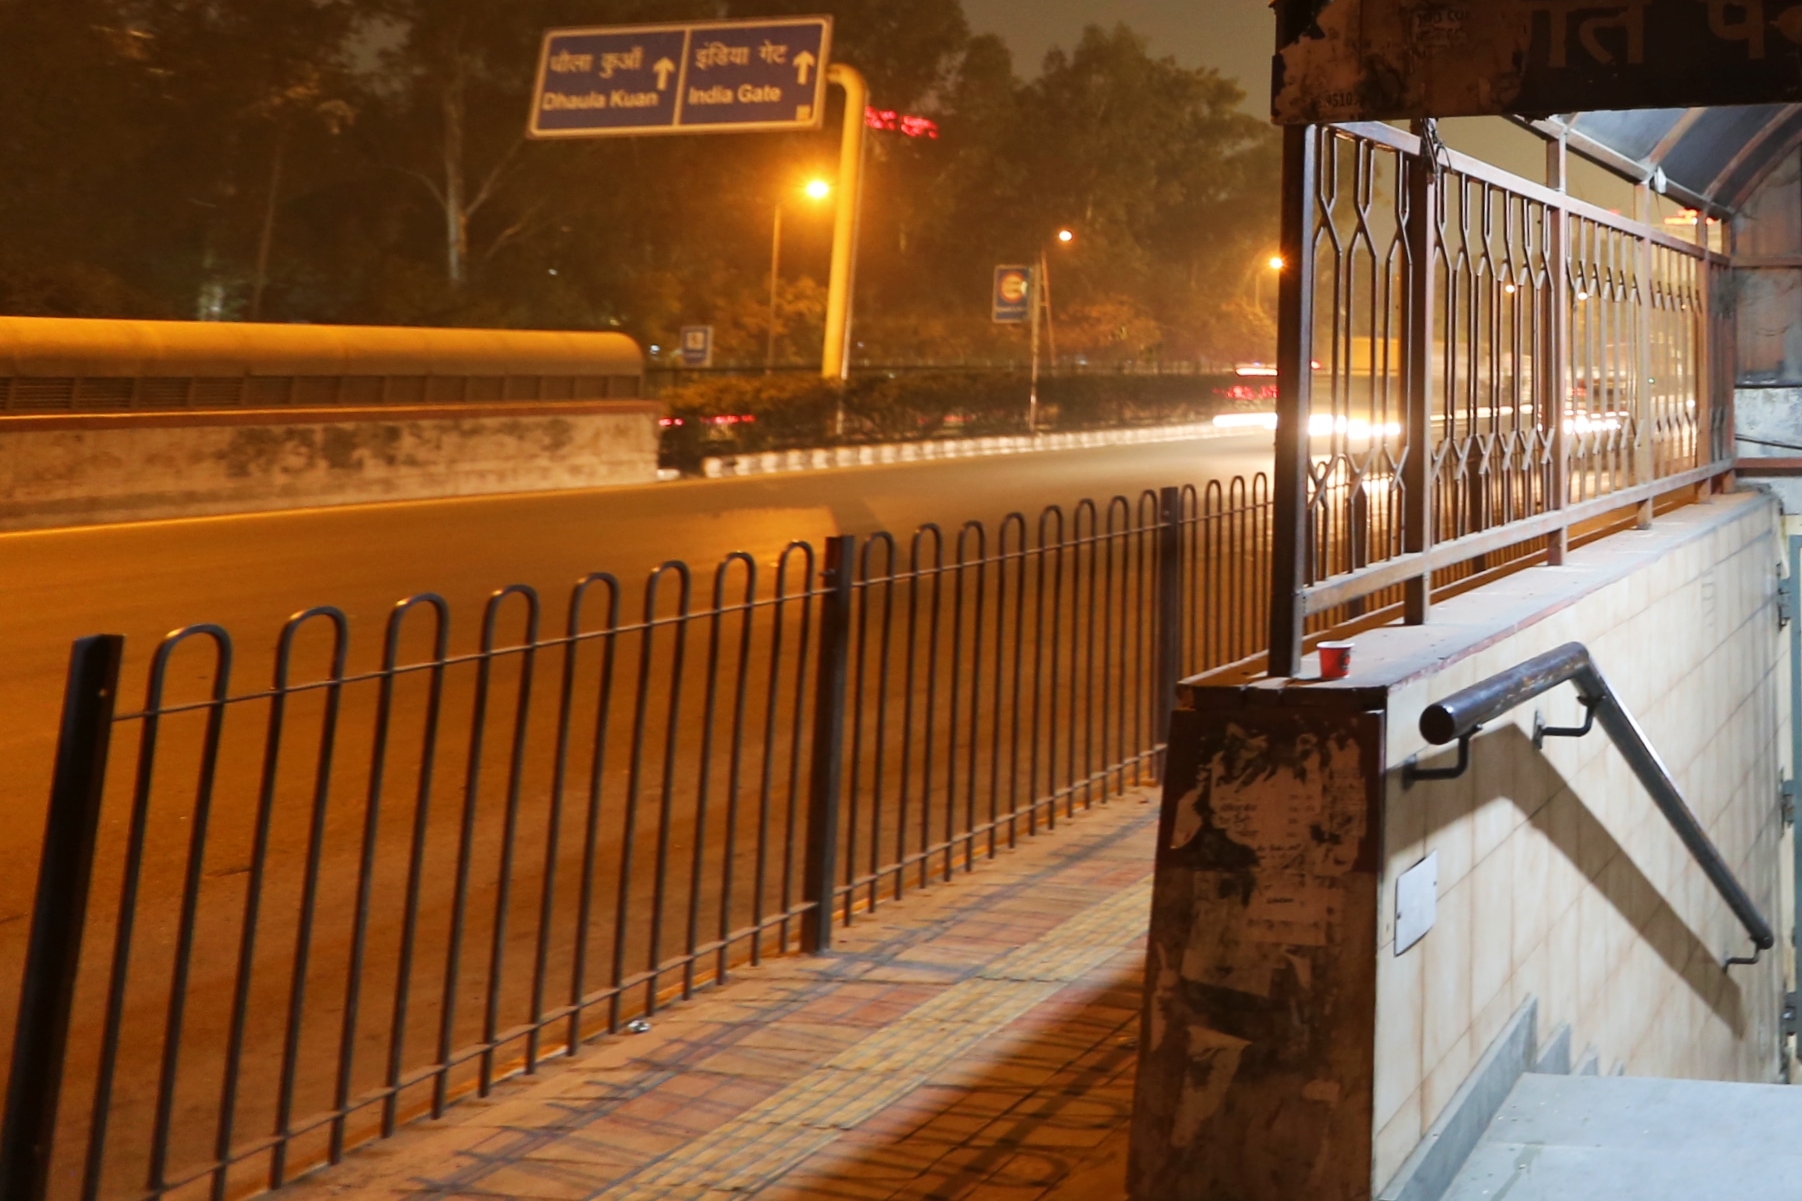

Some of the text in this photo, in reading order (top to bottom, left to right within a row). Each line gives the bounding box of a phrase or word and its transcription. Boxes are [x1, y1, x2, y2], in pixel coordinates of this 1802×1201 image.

[695, 38, 789, 70] इंडिया गेट
[542, 89, 659, 110] Dhaula Kuan
[688, 83, 783, 106] India Gate
